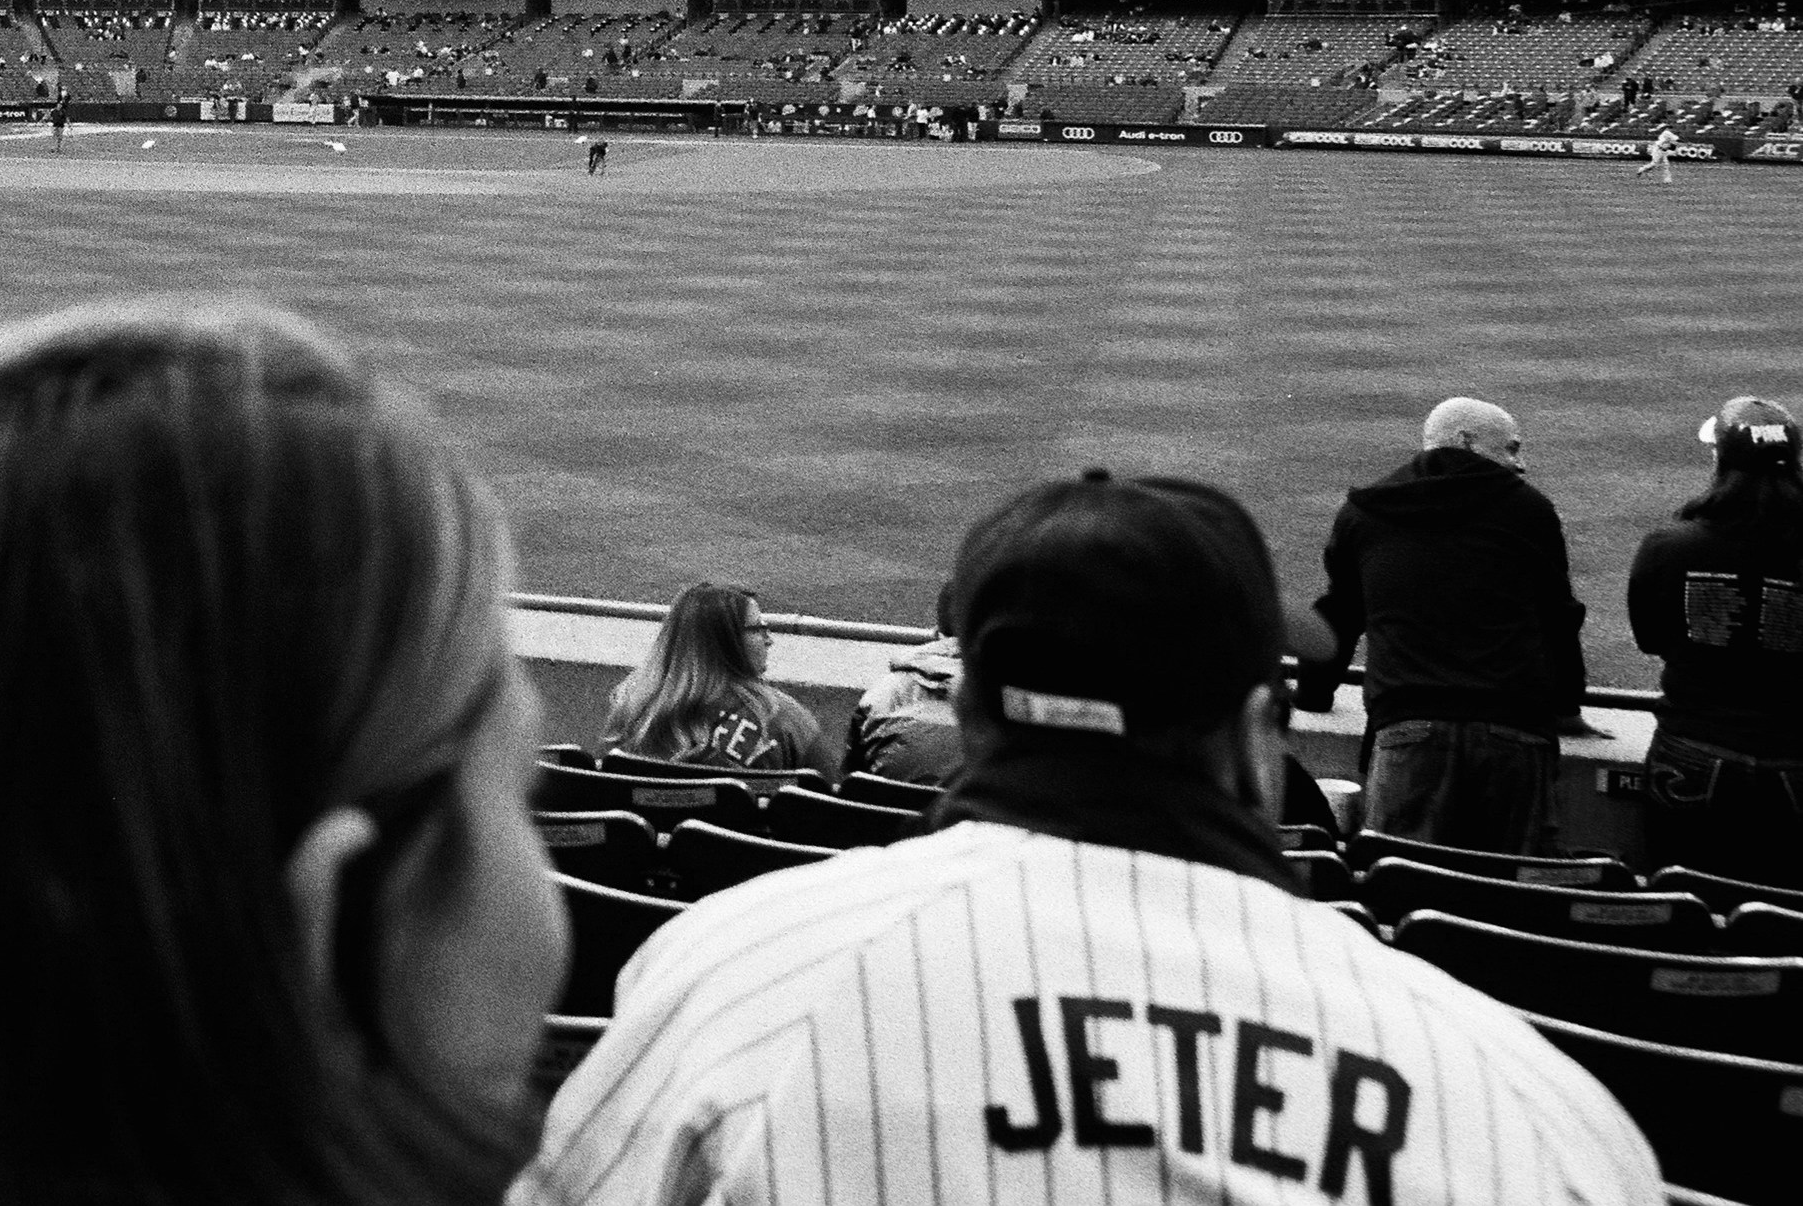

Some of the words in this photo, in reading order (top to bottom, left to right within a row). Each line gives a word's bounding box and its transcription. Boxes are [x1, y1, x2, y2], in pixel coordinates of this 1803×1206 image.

[1119, 130, 1146, 140] Audi
[1147, 132, 1186, 141] e-tron
[983, 994, 1414, 1206] JETER
